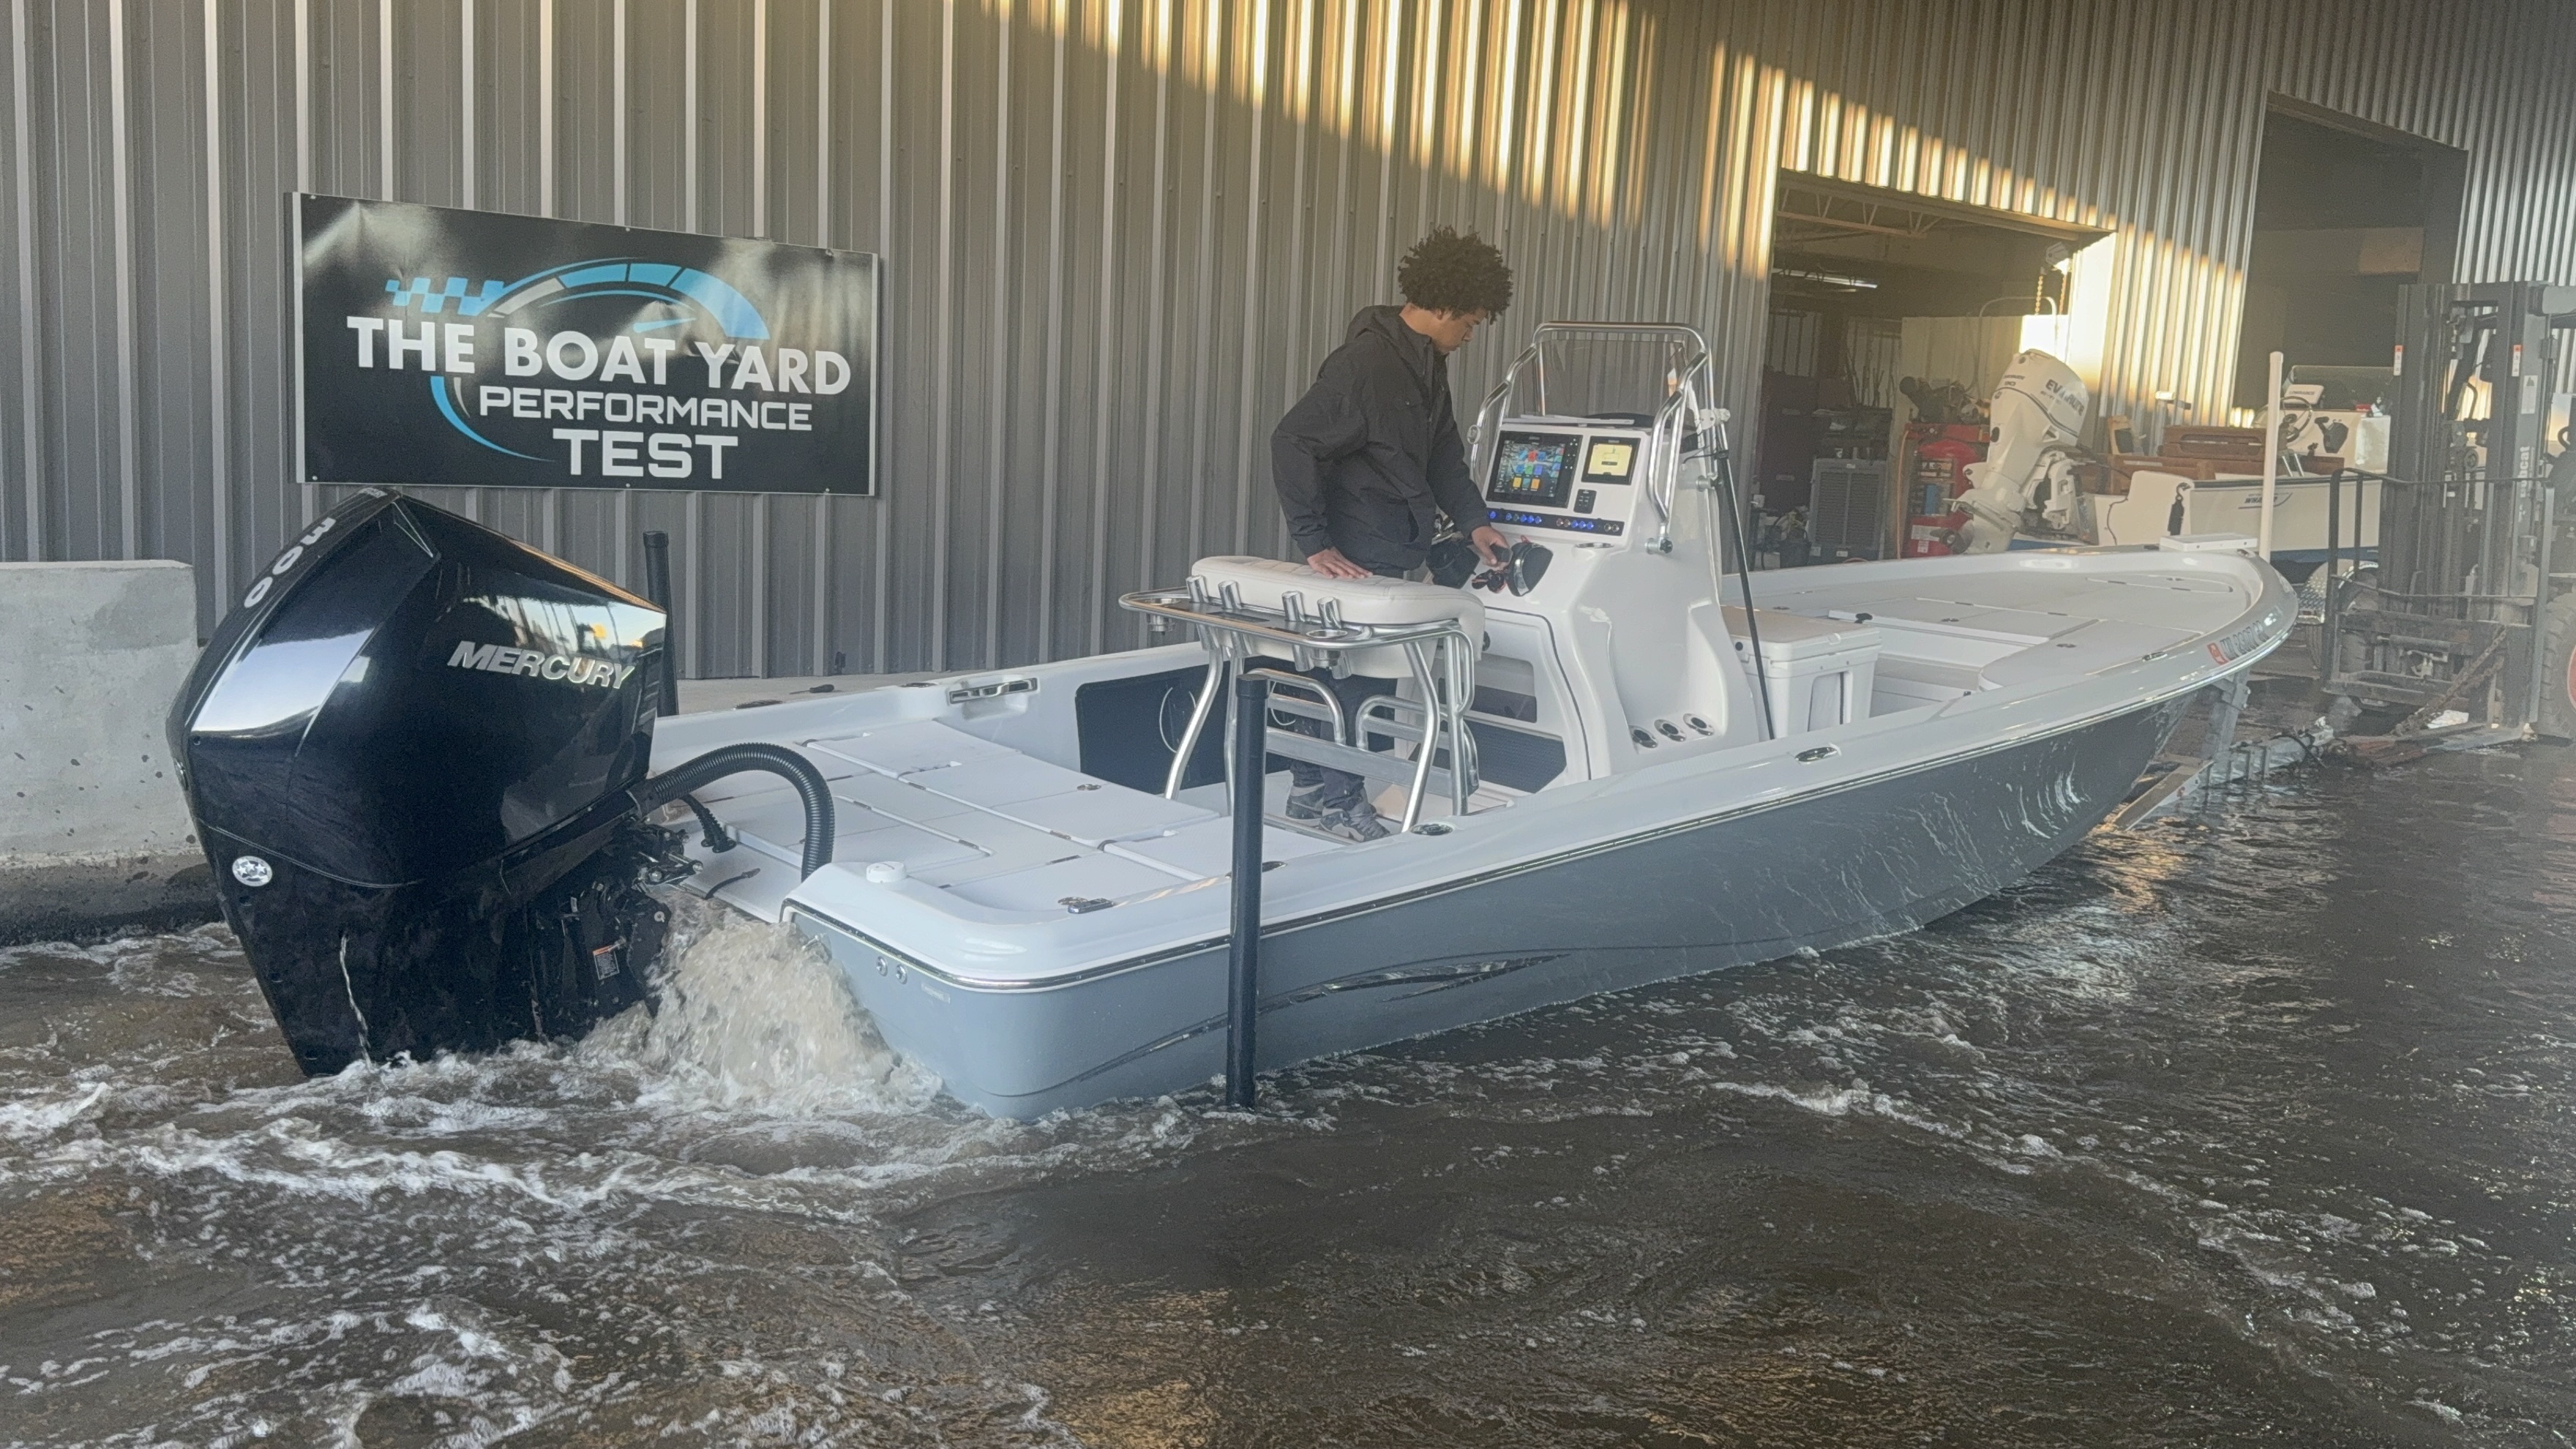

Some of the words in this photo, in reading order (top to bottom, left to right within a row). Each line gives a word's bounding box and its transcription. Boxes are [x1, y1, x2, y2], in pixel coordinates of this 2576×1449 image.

[346, 315, 476, 375] THE
[504, 327, 676, 386] BOAT
[694, 340, 852, 396] YARD
[479, 386, 813, 432] PERFORMANCE
[553, 427, 739, 480] TEST
[243, 516, 337, 609] 300
[447, 640, 635, 689] MERCURY
